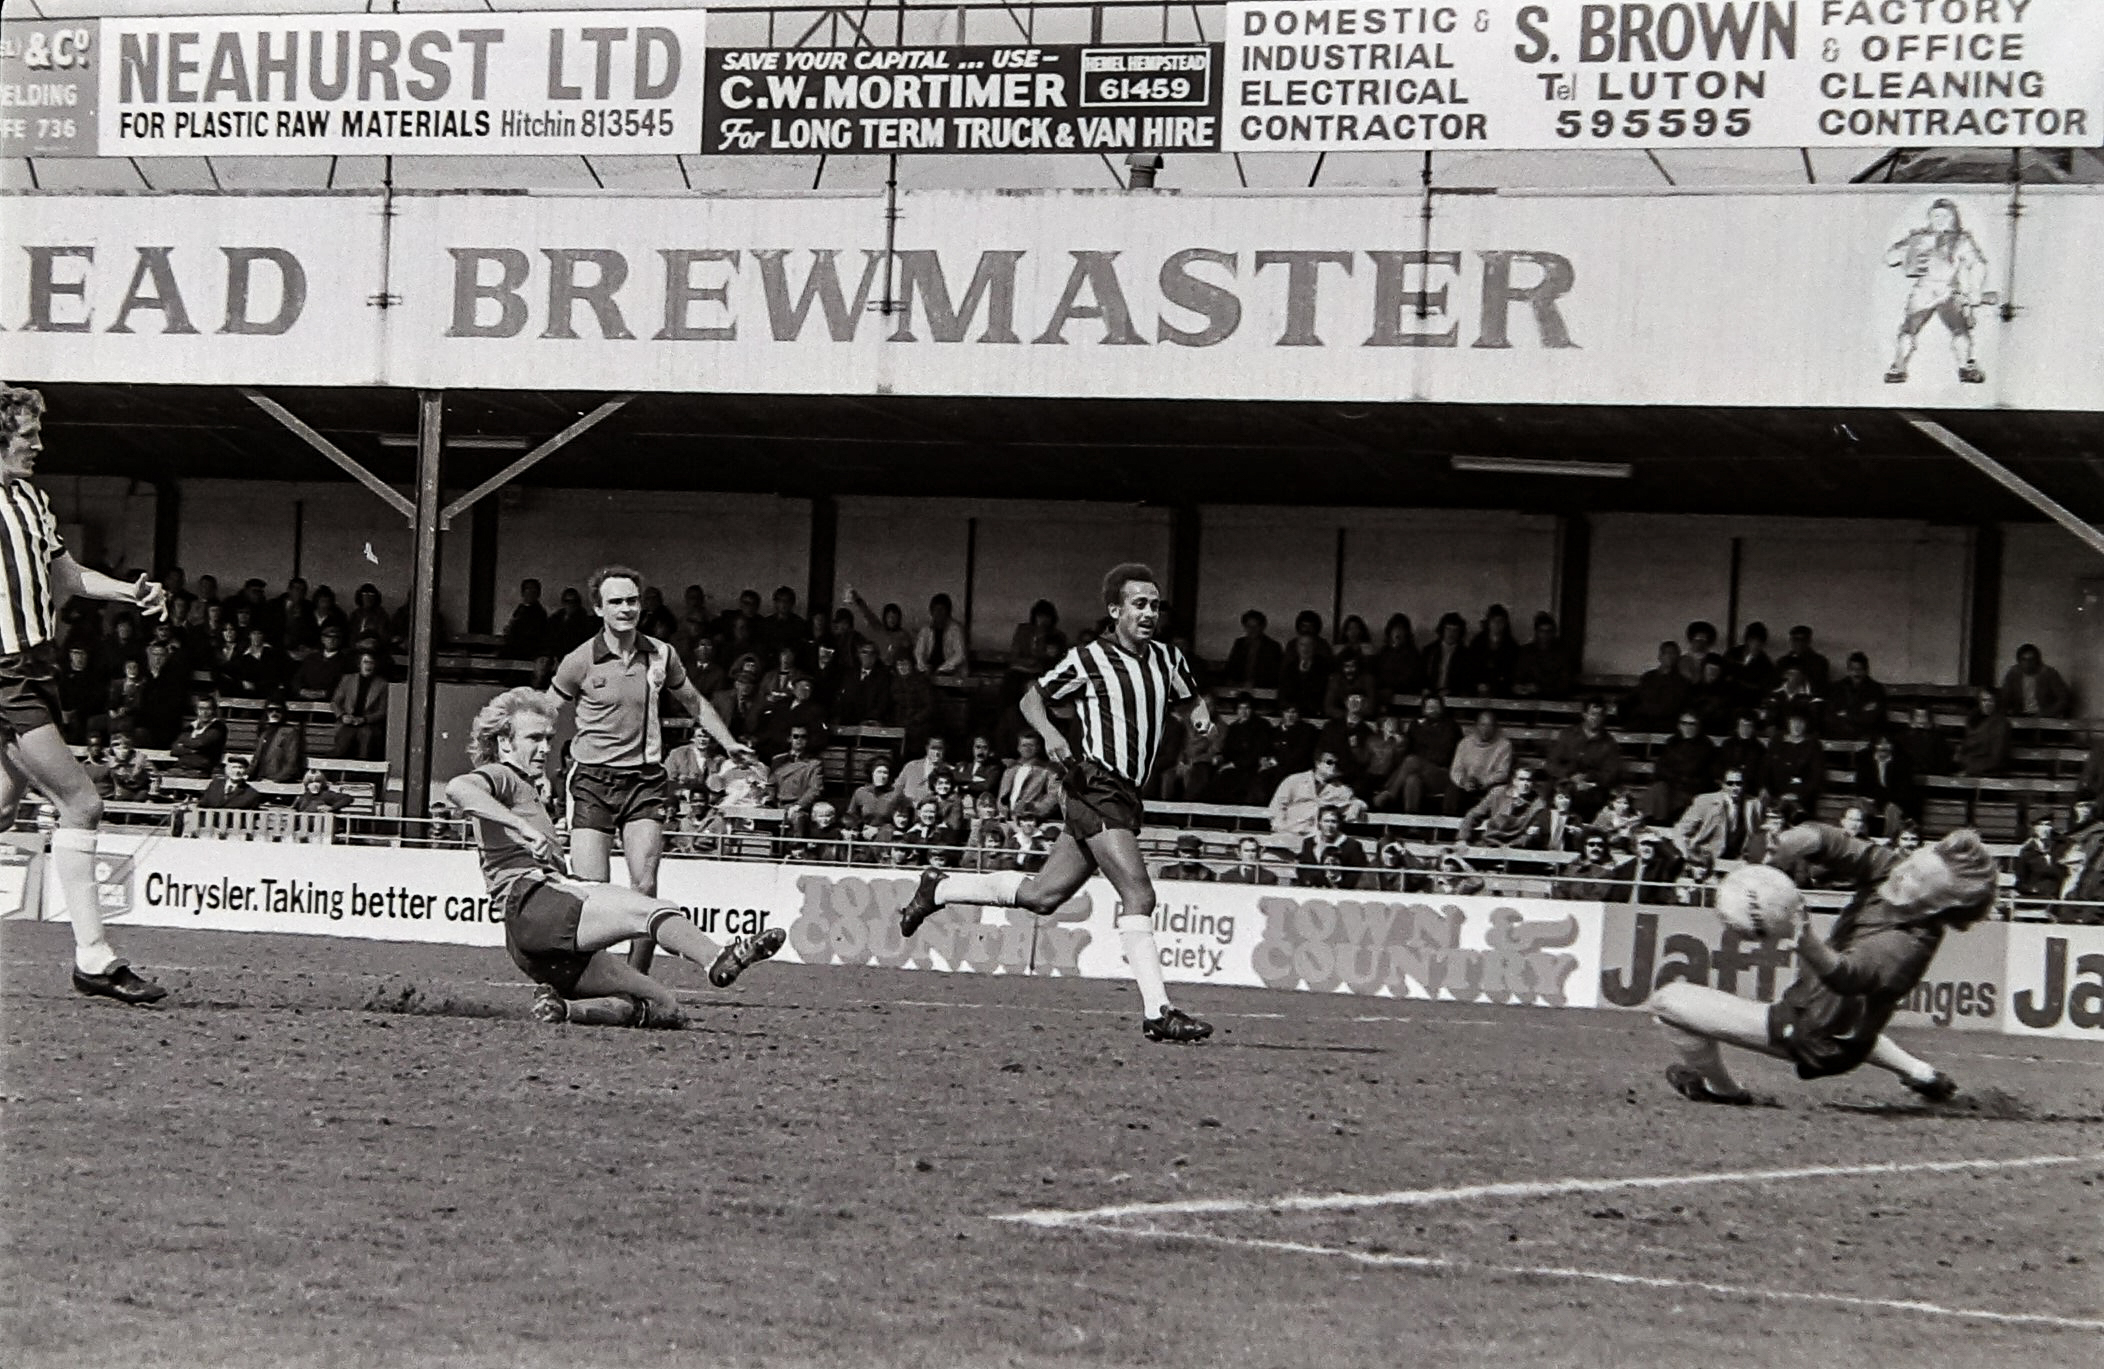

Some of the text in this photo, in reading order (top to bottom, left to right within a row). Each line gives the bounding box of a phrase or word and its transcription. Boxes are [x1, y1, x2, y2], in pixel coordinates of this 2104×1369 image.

[1244, 8, 1490, 36] DOMESTIC &
[1821, 0, 2031, 25] FACTORY
[1514, 1, 1797, 63] S. BROWN
[721, 52, 780, 70] SAVE
[784, 52, 848, 70] YOUR
[854, 51, 950, 69] CAPITAL
[1242, 43, 1455, 71] INDUSTRIAL
[1821, 33, 2025, 62] & OFFICE
[119, 27, 681, 103] NEAHURST LTD
[1127, 54, 1207, 71] HEMPSTEAD
[1100, 78, 1191, 100] 61459
[1241, 78, 1470, 106] ELECTRICAL
[1537, 70, 1766, 100] Tel LUTON
[1820, 71, 2045, 99] CLEANING
[37, 119, 77, 139] 736
[120, 108, 674, 138] FOR PLASTIC RAW MATERIALS Hitchin 813545
[718, 116, 1216, 150] For LONG TERM TRUCK & VAN HIRE
[1240, 113, 1488, 141] CONTRACTOR
[1555, 107, 1751, 138] 595595
[1818, 108, 2089, 136] CONTRACTOR
[0, 245, 1583, 349] EAD BREWMASTER
[352, 883, 437, 920] better
[444, 892, 504, 923] care
[725, 909, 770, 934] car
[1258, 897, 1466, 950] TOWN
[1251, 935, 1578, 1006] COUNTRY
[1601, 913, 1797, 1007] Jaff
[1897, 981, 1997, 1027] nges
